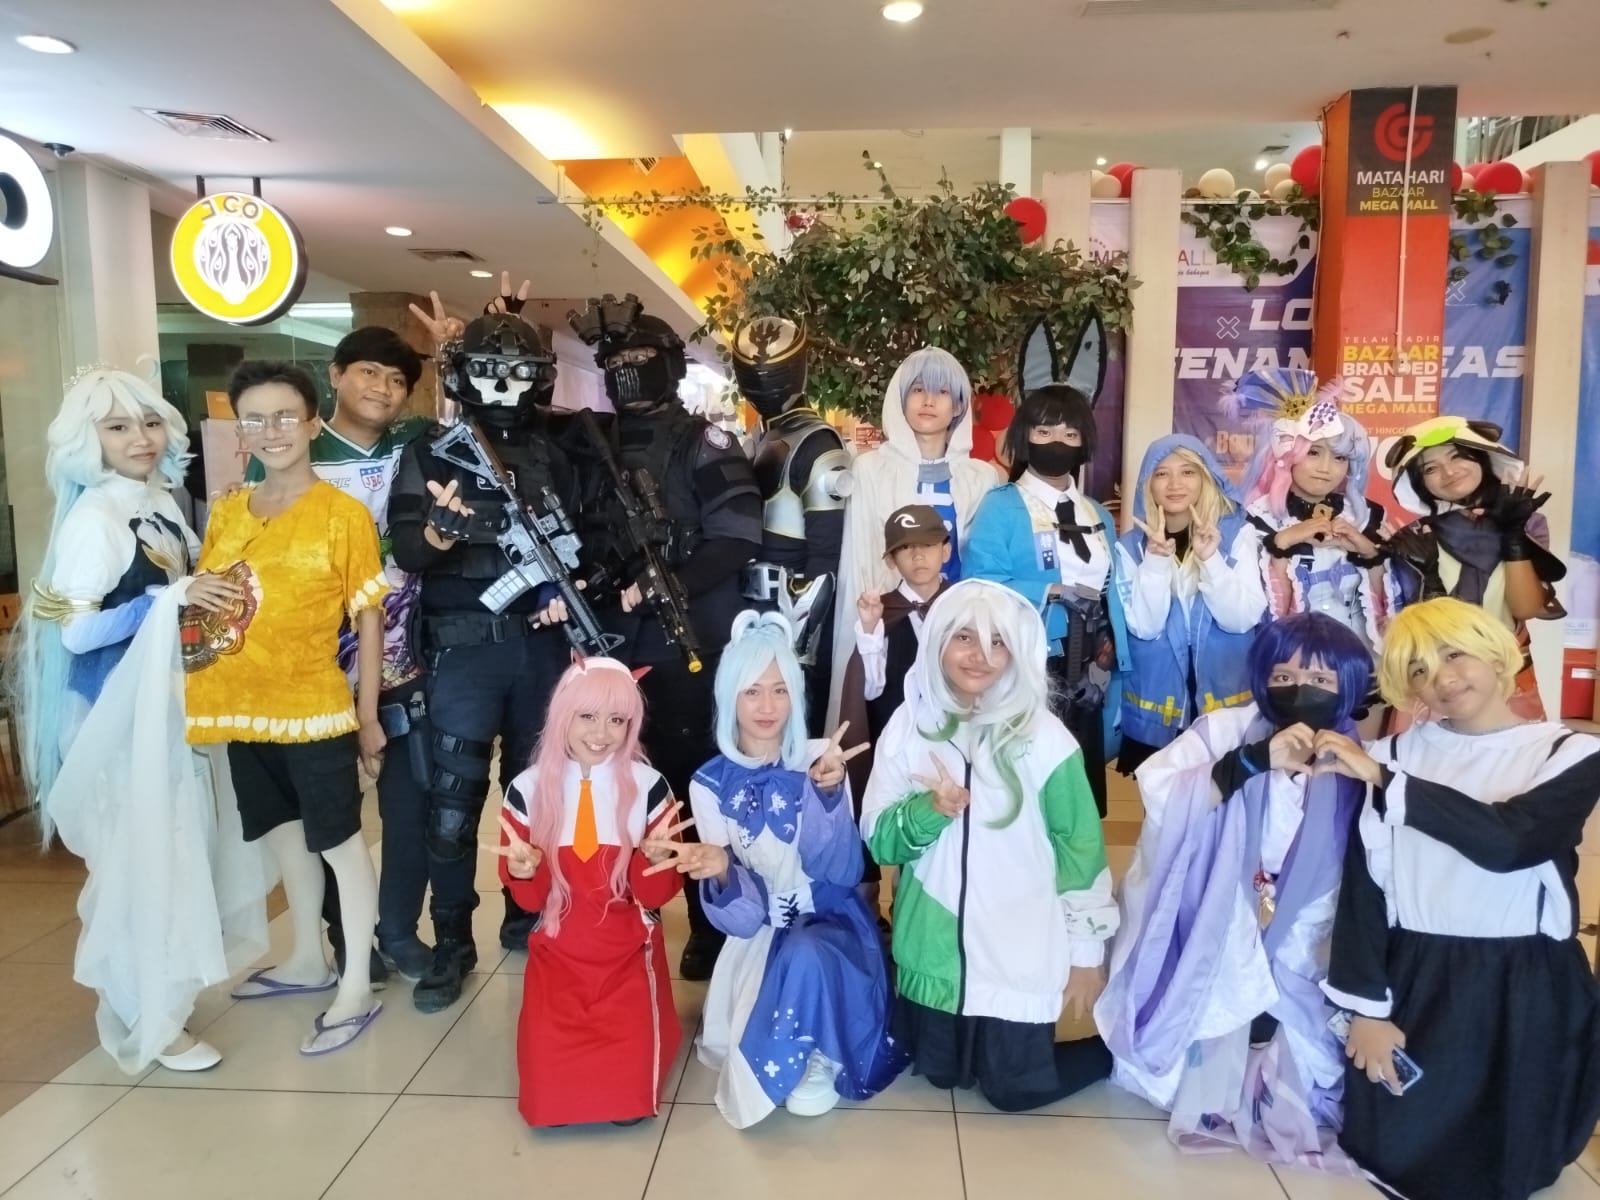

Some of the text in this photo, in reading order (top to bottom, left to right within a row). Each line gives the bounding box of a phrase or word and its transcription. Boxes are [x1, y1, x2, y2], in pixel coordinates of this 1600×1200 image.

[1356, 170, 1445, 185] MATAHARI
[1359, 200, 1399, 211] MEGA
[1404, 335, 1440, 343] ADIR
[1343, 344, 1440, 361] BAZAR
[1342, 361, 1438, 376] BRANED
[1341, 376, 1438, 402] SALE
[1342, 403, 1436, 414] MEGA MALL
